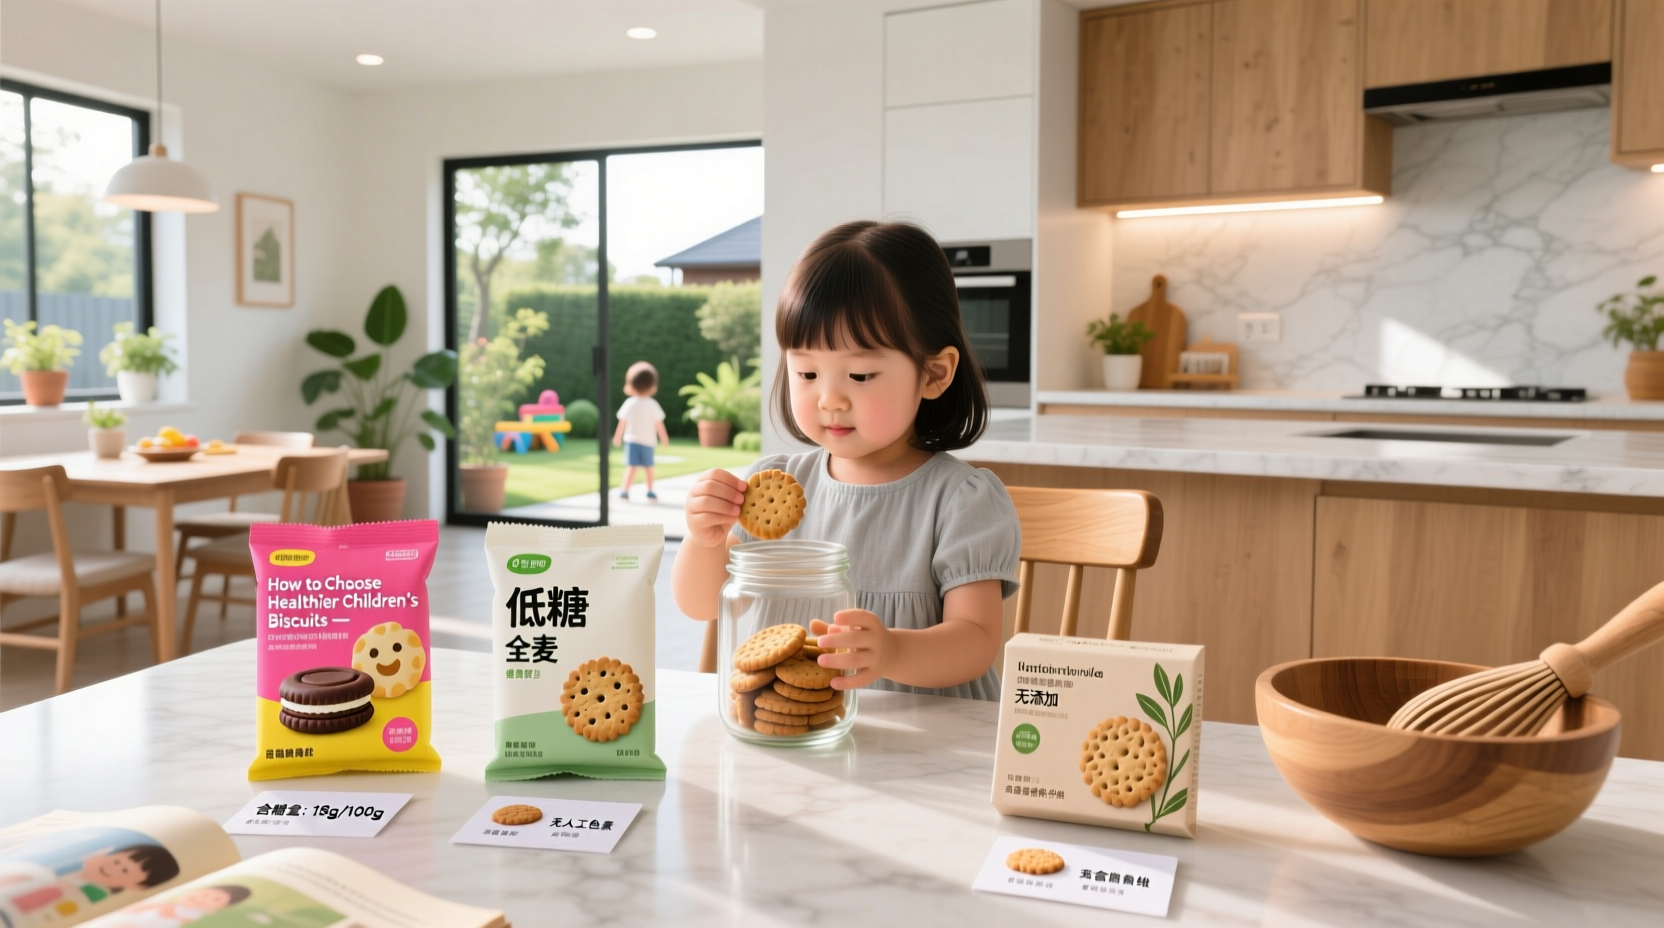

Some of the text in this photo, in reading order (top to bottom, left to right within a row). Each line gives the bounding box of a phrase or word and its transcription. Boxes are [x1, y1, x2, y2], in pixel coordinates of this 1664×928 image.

[267, 575, 382, 591] How to Choose
[267, 592, 419, 609] Healthier Children's
[505, 586, 590, 628] 低糖
[267, 613, 328, 628] Biscuits
[505, 634, 558, 664] 全麦
[1014, 688, 1059, 707] 无添加
